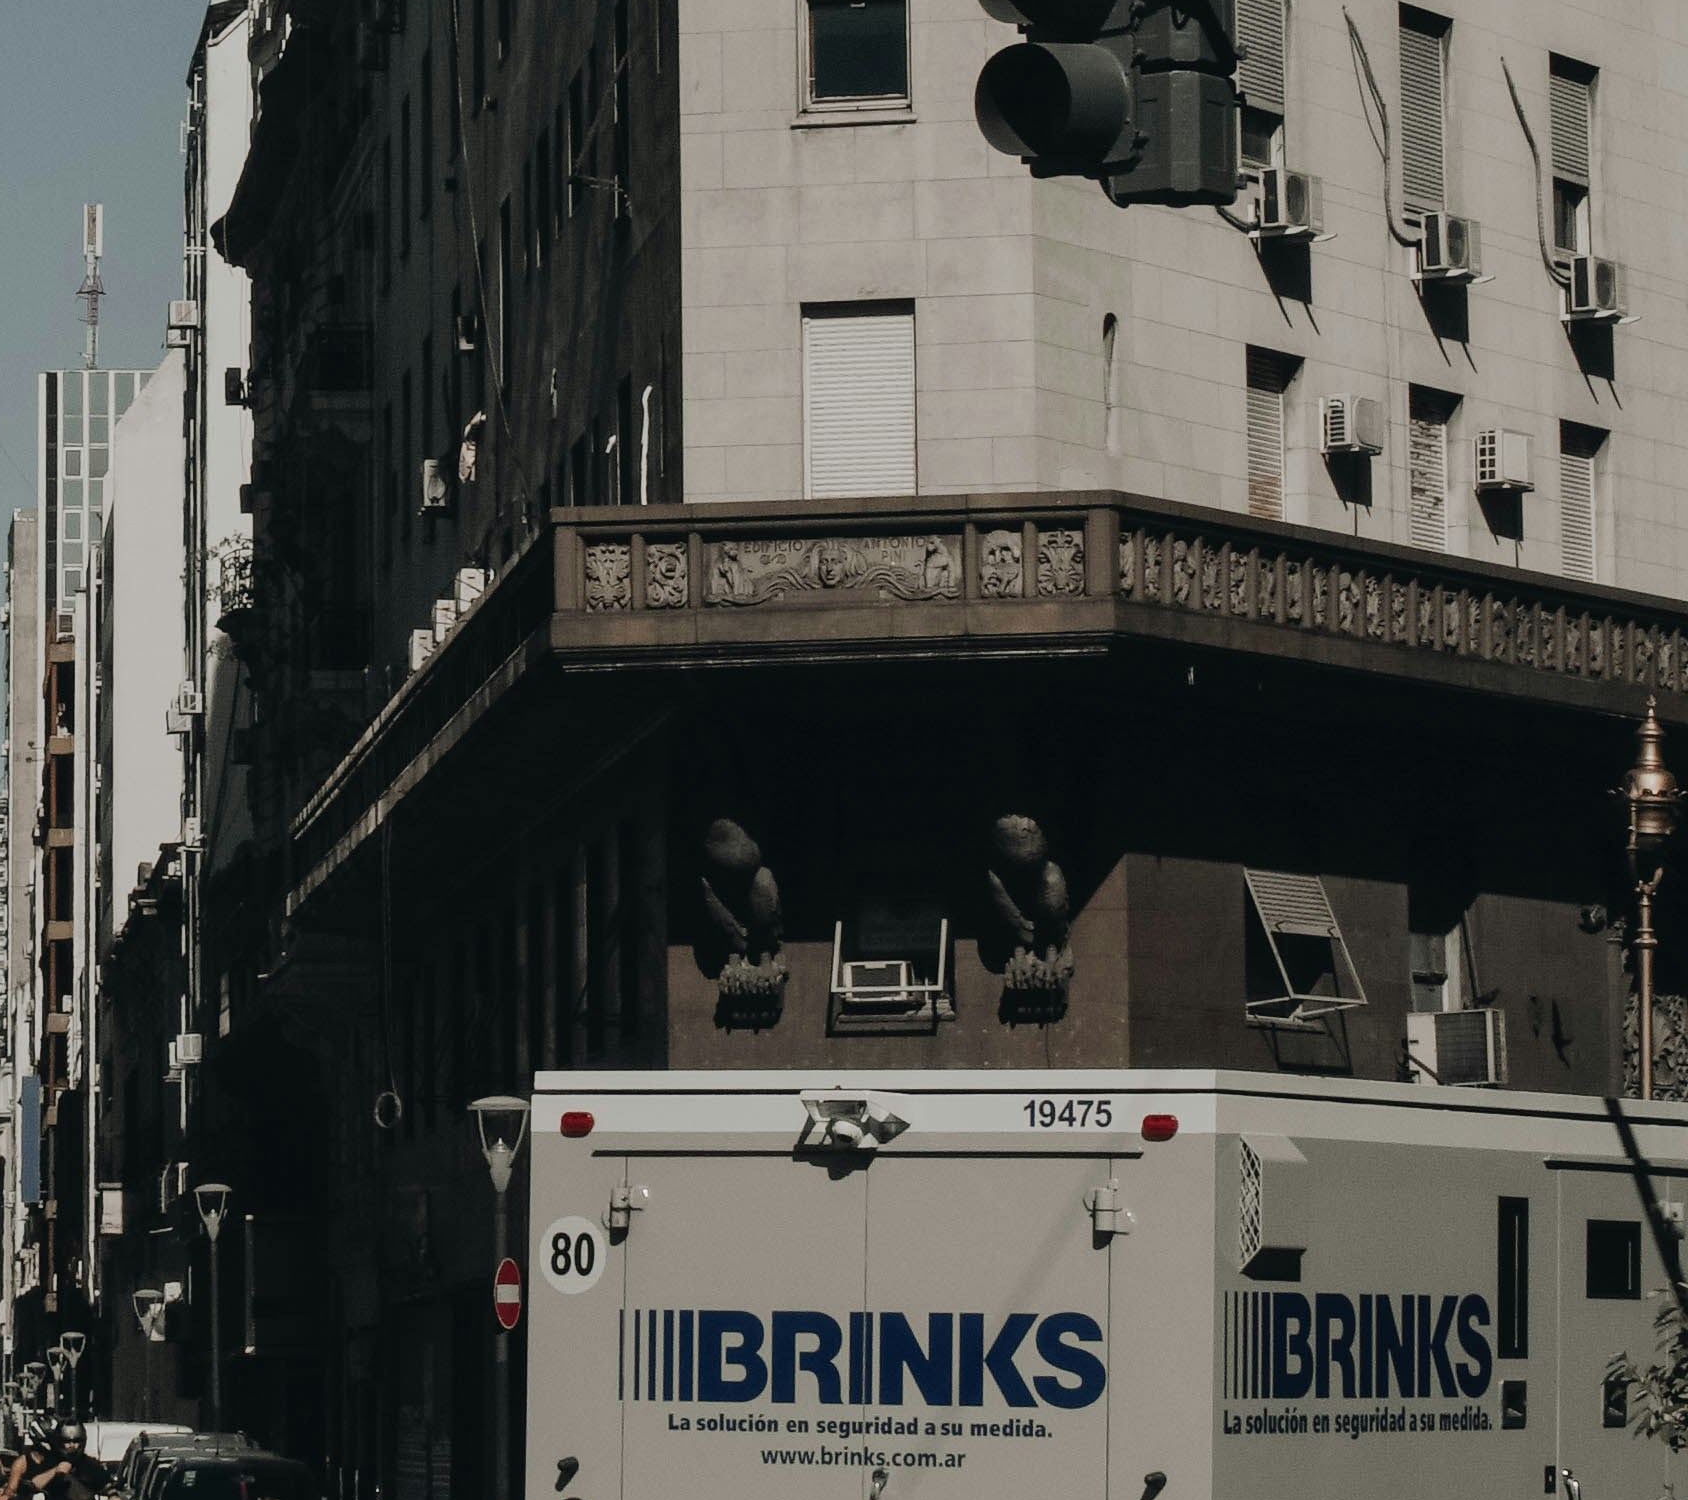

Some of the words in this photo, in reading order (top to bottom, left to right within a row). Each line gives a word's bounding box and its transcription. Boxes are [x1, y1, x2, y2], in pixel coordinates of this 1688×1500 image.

[1023, 1099, 1113, 1128] 19475
[551, 1232, 595, 1276] 80
[698, 1309, 1108, 1410] BRINKS
[1272, 1292, 1493, 1399] BRINKS
[668, 1413, 691, 1432] La
[696, 1412, 779, 1434] solución
[786, 1420, 809, 1434] en
[816, 1415, 919, 1438] seguridad
[924, 1421, 936, 1436] a
[940, 1421, 964, 1437] su
[970, 1416, 1053, 1438] medida.
[1223, 1410, 1242, 1435] La
[1246, 1407, 1308, 1434] solución
[1313, 1413, 1330, 1433] en
[1335, 1406, 1406, 1439] seguridad
[1409, 1413, 1417, 1432] a
[1420, 1412, 1435, 1432] su
[1439, 1406, 1492, 1432] medida.
[761, 1446, 967, 1469] www.brinks.com.ar
